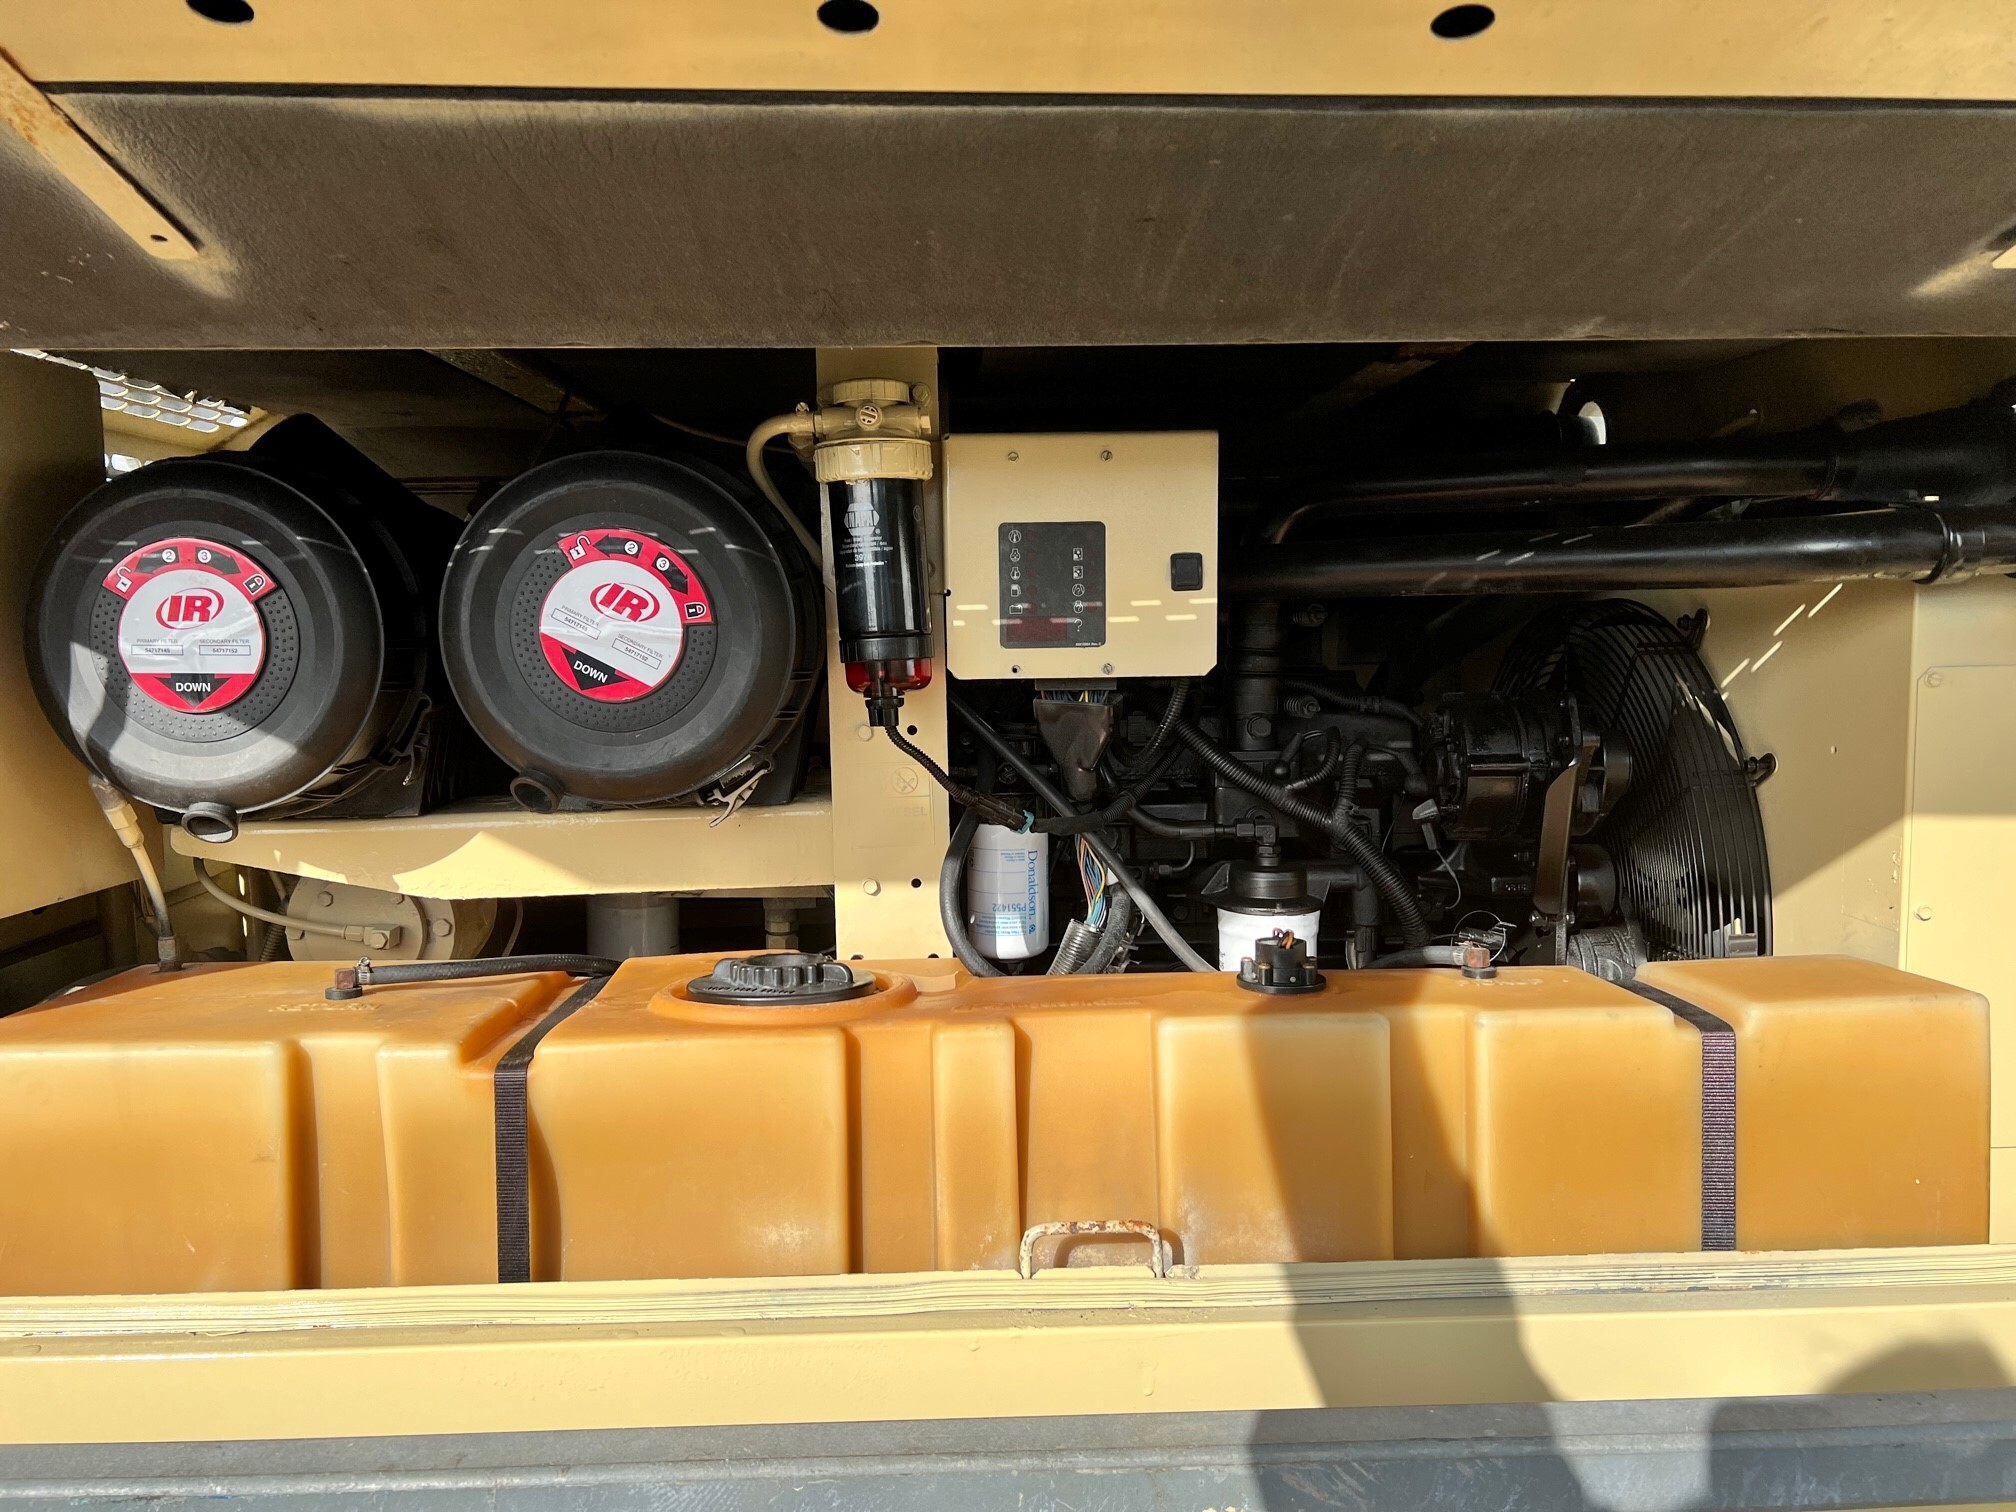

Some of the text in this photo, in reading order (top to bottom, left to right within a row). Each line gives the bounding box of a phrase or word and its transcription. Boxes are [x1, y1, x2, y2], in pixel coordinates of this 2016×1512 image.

[849, 511, 874, 528] NAPA
[628, 542, 636, 553] 2
[165, 551, 209, 561] 2 3
[659, 558, 668, 569] 3
[167, 595, 213, 622] IR
[598, 582, 649, 623] IR
[561, 605, 583, 621] PRIMARY
[618, 633, 663, 659] SECONDARY FILTER
[573, 660, 608, 683] DOWN
[175, 682, 211, 692] DOWN
